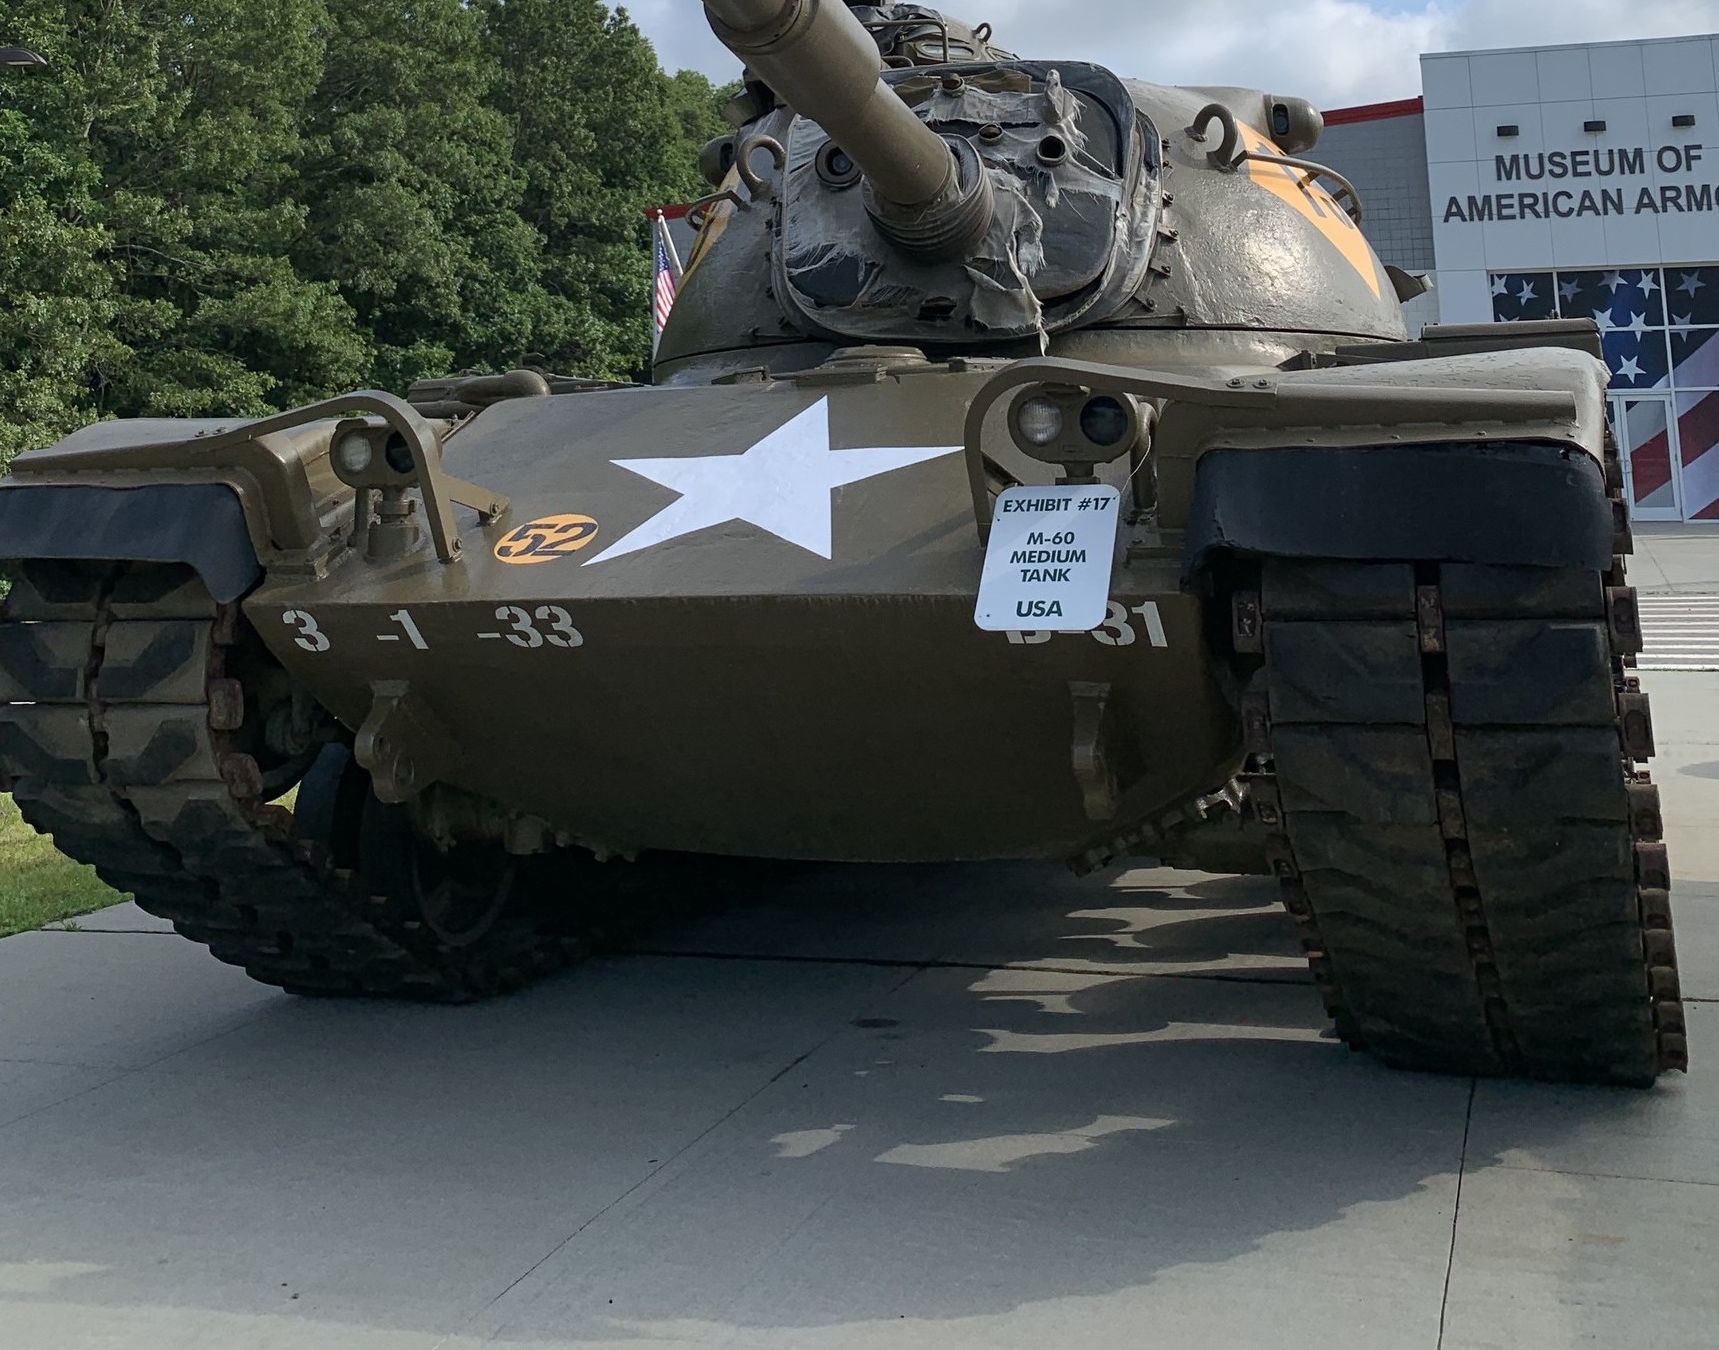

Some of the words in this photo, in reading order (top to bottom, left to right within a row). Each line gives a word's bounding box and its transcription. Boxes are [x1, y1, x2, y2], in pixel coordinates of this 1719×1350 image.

[1495, 148, 1645, 182] MUSEUM
[1657, 144, 1703, 175] OF
[1443, 188, 1624, 223] AMERICAN
[1002, 498, 1072, 513] EXHIBIT
[1077, 497, 1112, 512] #17
[497, 521, 599, 558] 52
[1026, 531, 1075, 546] M-60
[1009, 549, 1087, 564] MEDIUM
[1020, 568, 1072, 583] TANK
[1015, 600, 1064, 618] USA
